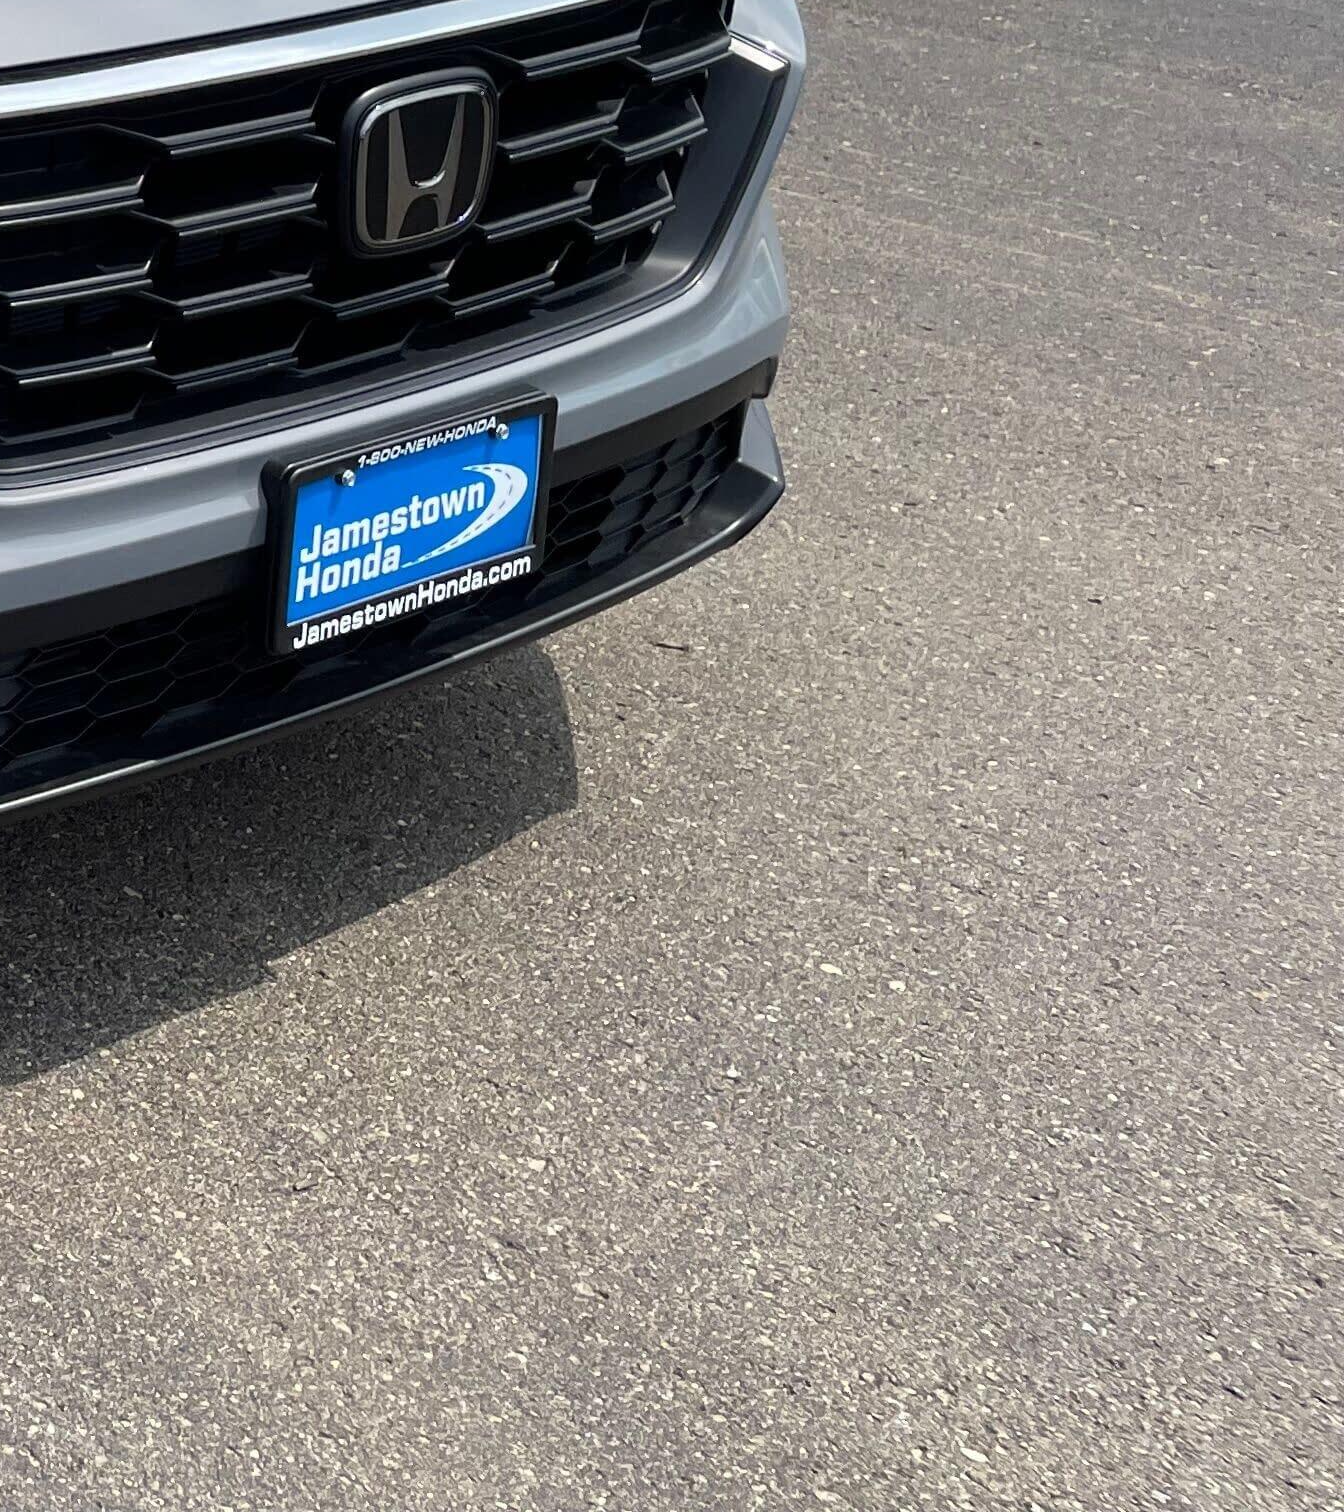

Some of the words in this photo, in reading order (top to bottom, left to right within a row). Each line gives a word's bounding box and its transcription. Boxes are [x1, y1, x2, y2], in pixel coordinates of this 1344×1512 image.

[358, 416, 497, 468] 1-800-NEW-HONDA
[300, 481, 485, 564] Jamestown
[293, 556, 532, 650] JamestownHonda.com
[295, 542, 401, 603] Honda
